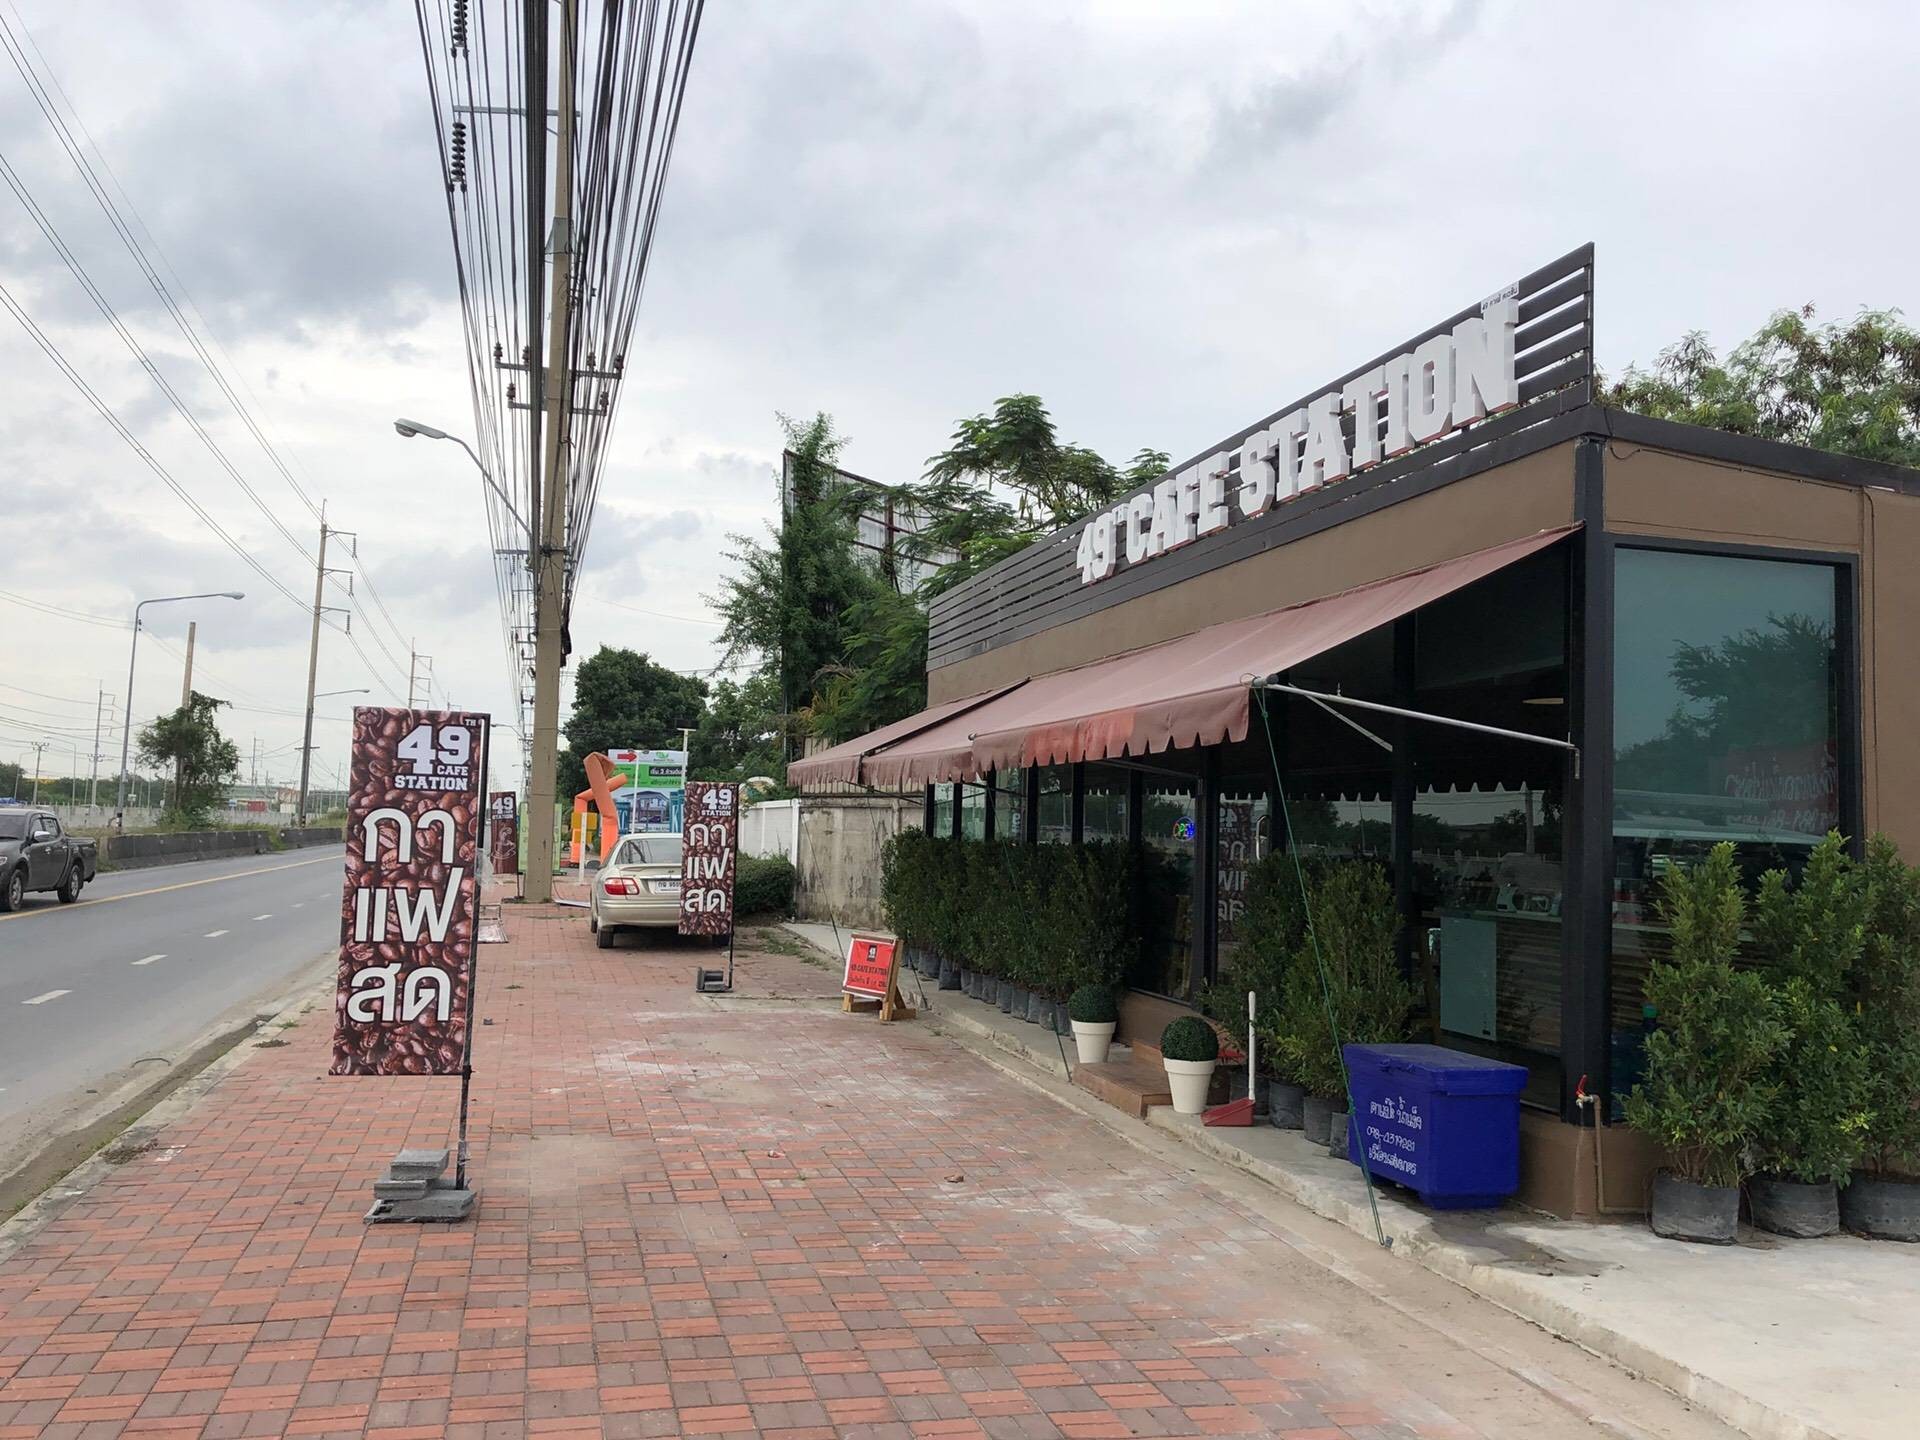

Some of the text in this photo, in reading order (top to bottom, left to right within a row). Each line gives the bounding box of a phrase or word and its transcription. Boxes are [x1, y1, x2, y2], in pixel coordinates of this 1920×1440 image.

[1076, 512, 1117, 585] 49
[1126, 450, 1231, 566] CAFE
[1239, 299, 1519, 517] STATION
[397, 718, 477, 775] 49 TH
[394, 775, 468, 791] STATION
[437, 765, 469, 776] CAFE
[492, 796, 514, 814] 49
[702, 788, 733, 810] 49
[363, 807, 455, 864] กา
[689, 823, 727, 847] กา
[686, 847, 730, 880] แฟ
[354, 867, 464, 943] แฟ
[684, 887, 726, 913] สด
[347, 962, 452, 1022] สด
